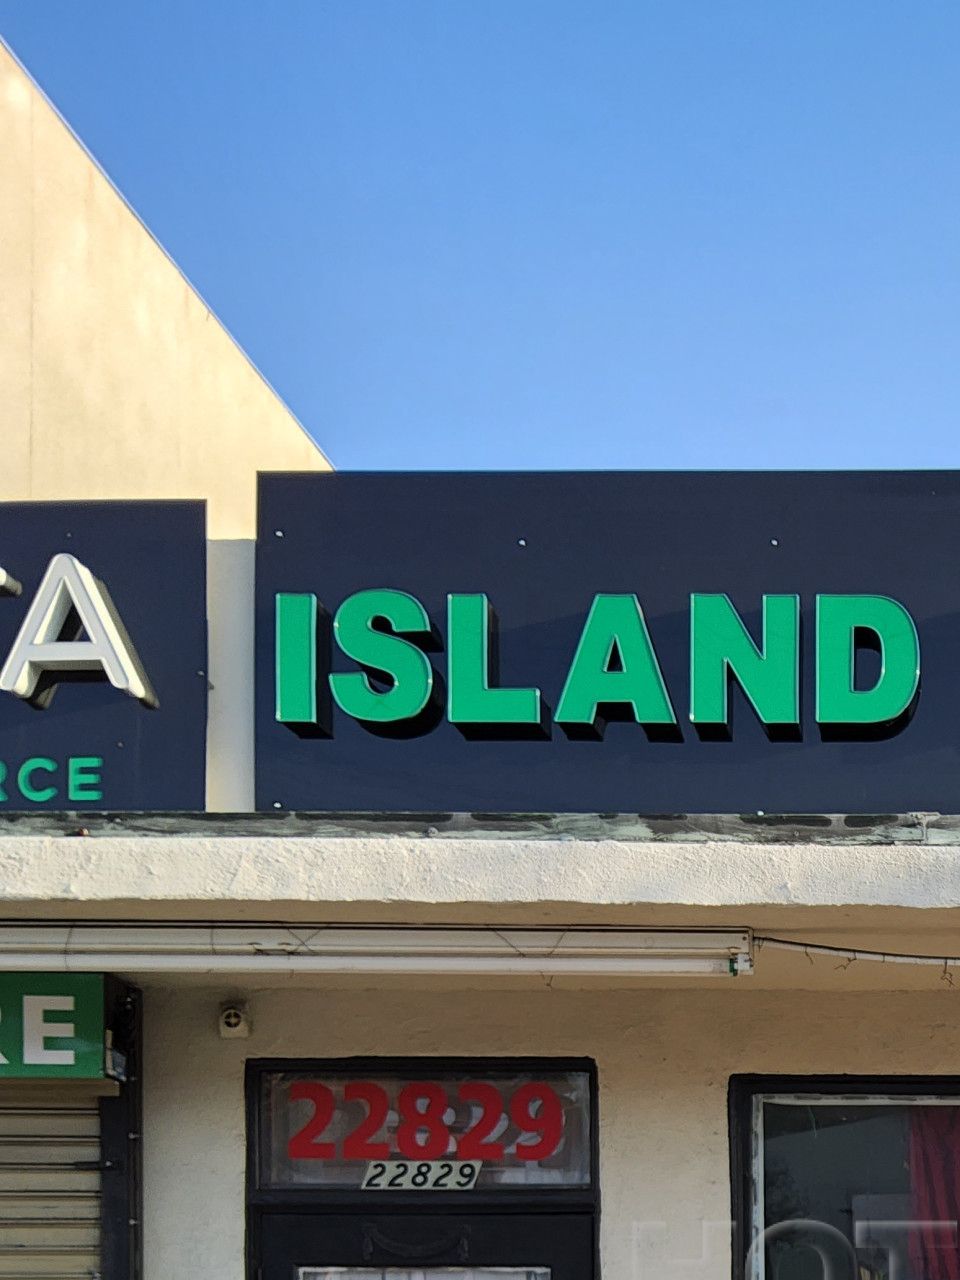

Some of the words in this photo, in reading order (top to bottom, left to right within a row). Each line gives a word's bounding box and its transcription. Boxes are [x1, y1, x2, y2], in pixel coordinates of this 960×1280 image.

[275, 589, 919, 724] ISLAND
[0, 756, 104, 803] CE
[0, 994, 76, 1065] E
[287, 1082, 564, 1161] 22829
[365, 1163, 477, 1188] 22829
